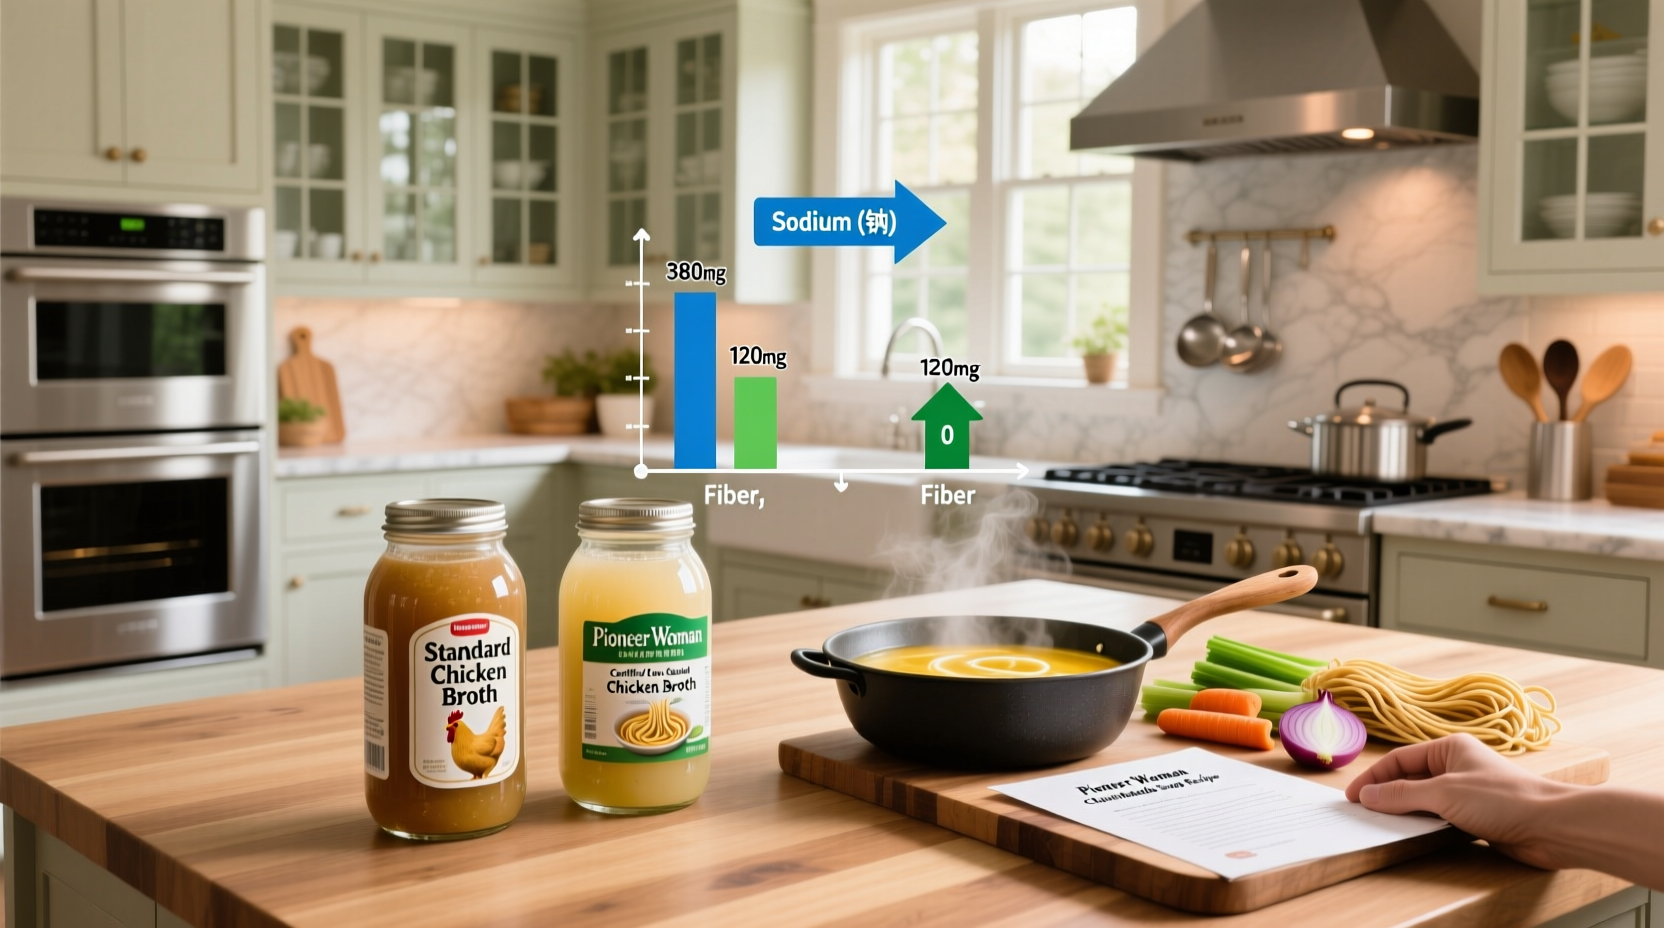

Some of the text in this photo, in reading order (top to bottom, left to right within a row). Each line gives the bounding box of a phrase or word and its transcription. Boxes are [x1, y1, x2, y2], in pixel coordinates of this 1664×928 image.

[592, 625, 703, 648] Pioneer Woman
[424, 636, 511, 662] Standard
[430, 662, 507, 685] Chicken
[441, 684, 498, 706] Broth
[606, 677, 697, 694] Chicken Broth
